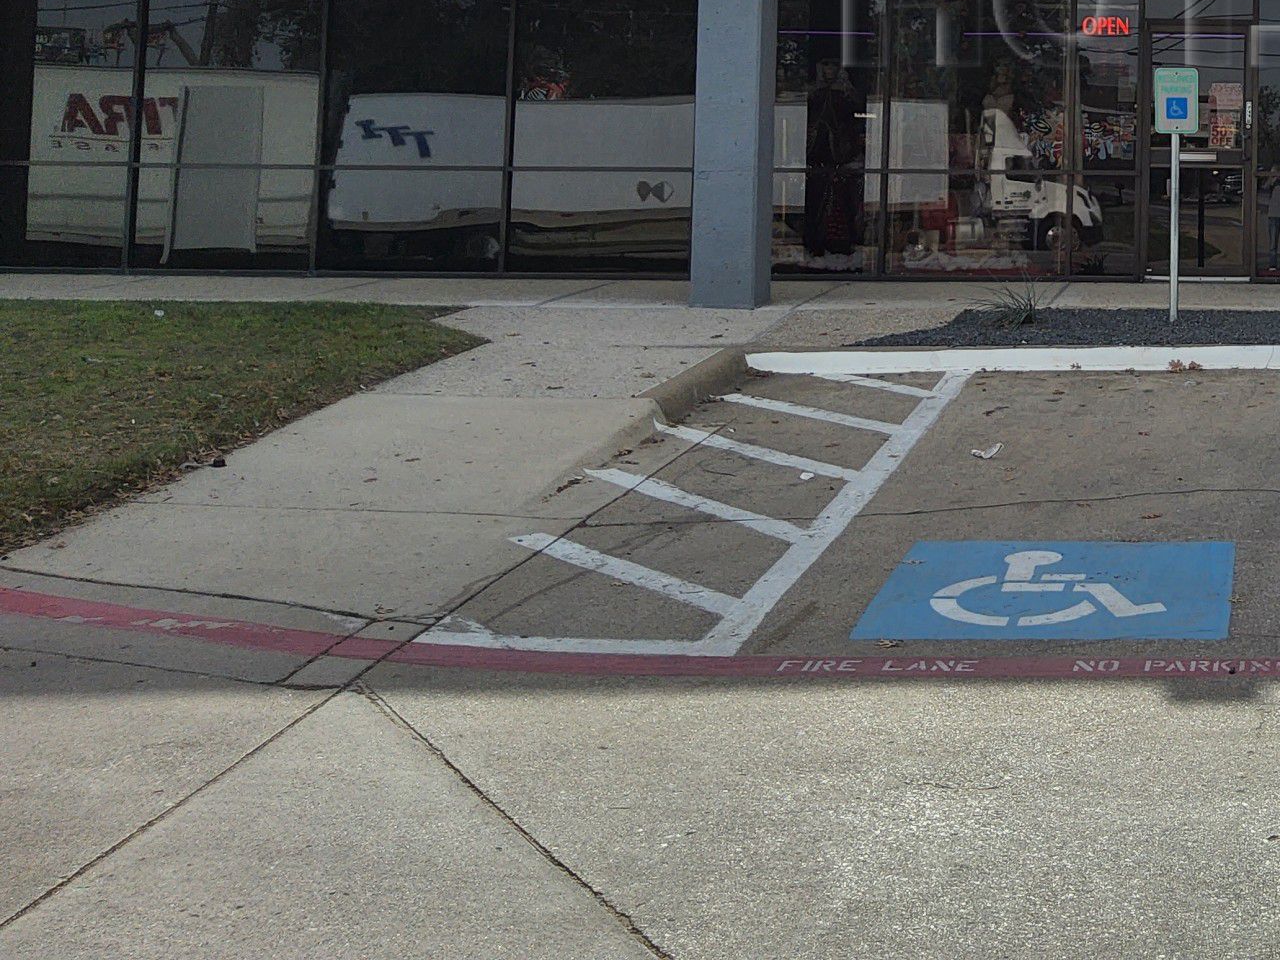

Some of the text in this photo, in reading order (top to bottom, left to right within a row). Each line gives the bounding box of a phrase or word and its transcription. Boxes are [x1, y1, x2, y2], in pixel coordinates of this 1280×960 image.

[1081, 16, 1130, 36] OPEN
[776, 660, 862, 672] FIRE
[881, 660, 980, 672] LANE
[1072, 660, 1120, 672] NO
